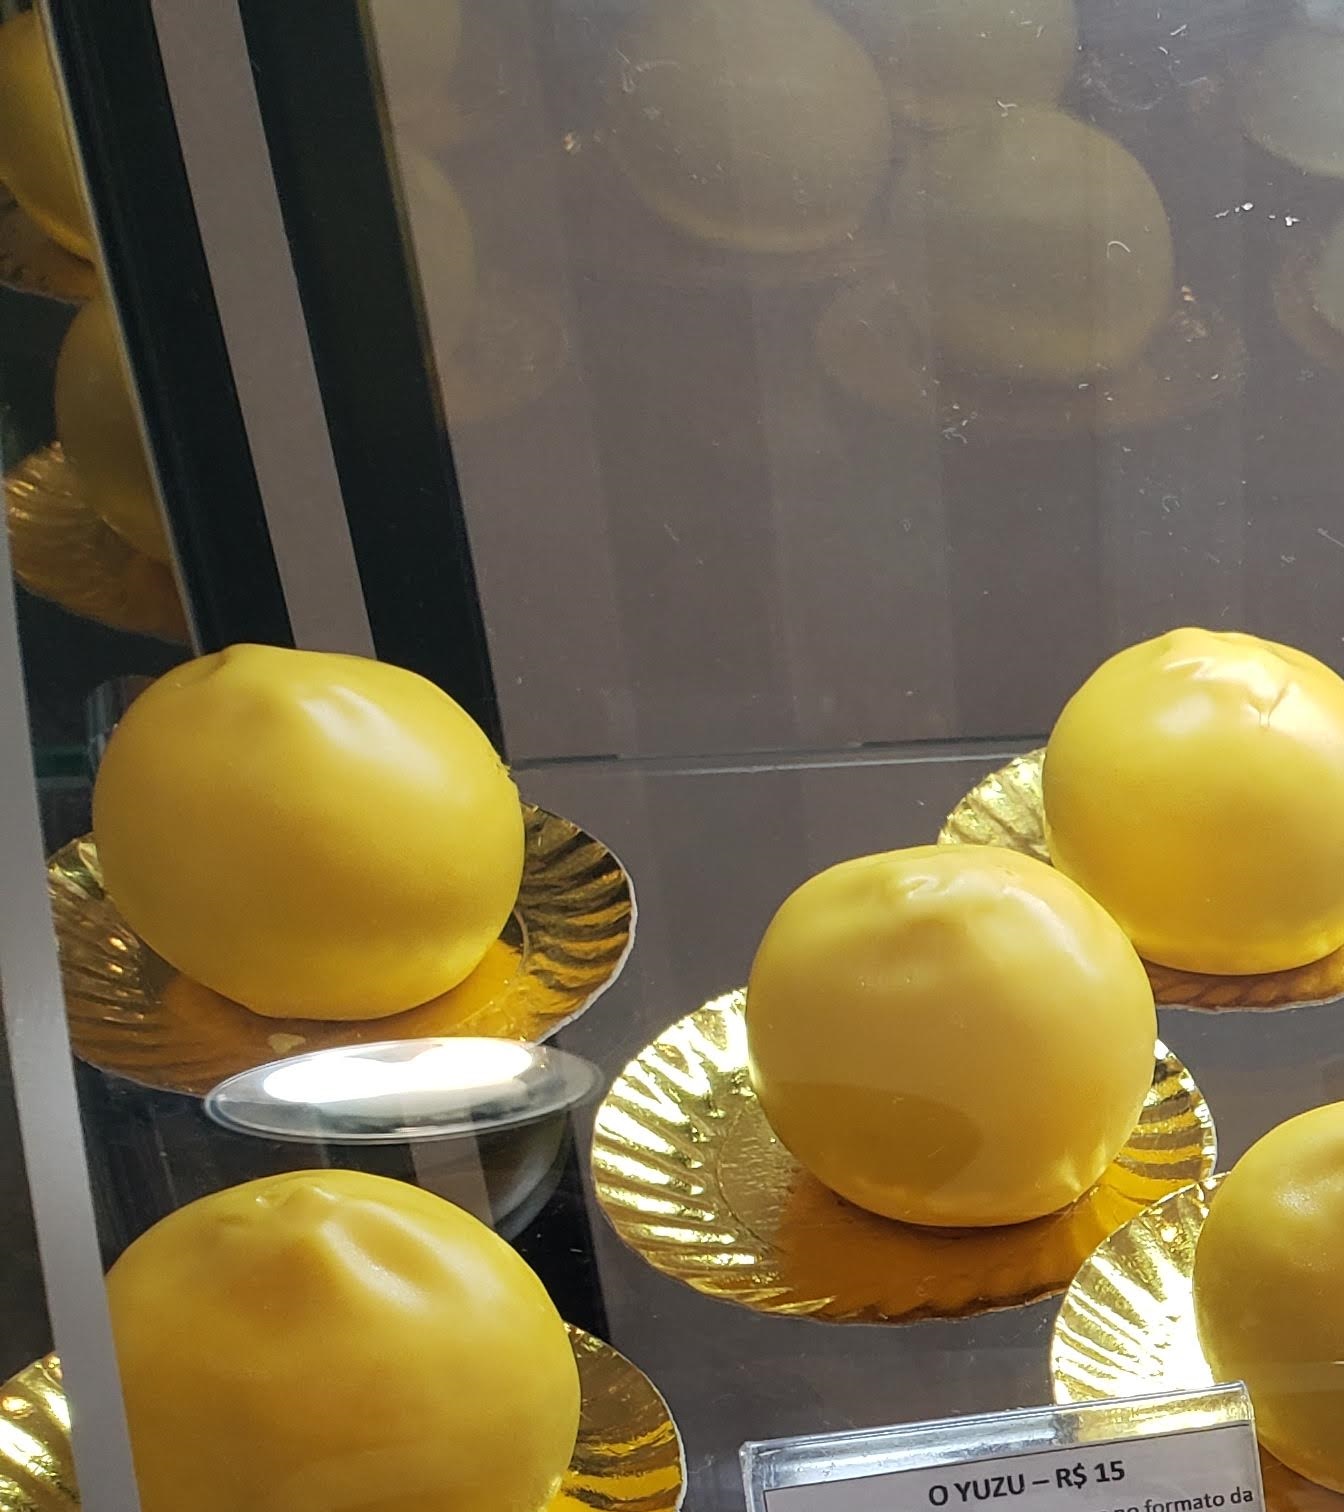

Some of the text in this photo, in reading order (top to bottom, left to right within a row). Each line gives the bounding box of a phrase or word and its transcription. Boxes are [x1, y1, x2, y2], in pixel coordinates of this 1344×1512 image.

[929, 1485, 948, 1506] O
[954, 1474, 1024, 1502] YUZU
[1056, 1463, 1087, 1489] R$
[1094, 1461, 1124, 1482] 15
[1231, 1487, 1253, 1504] da
